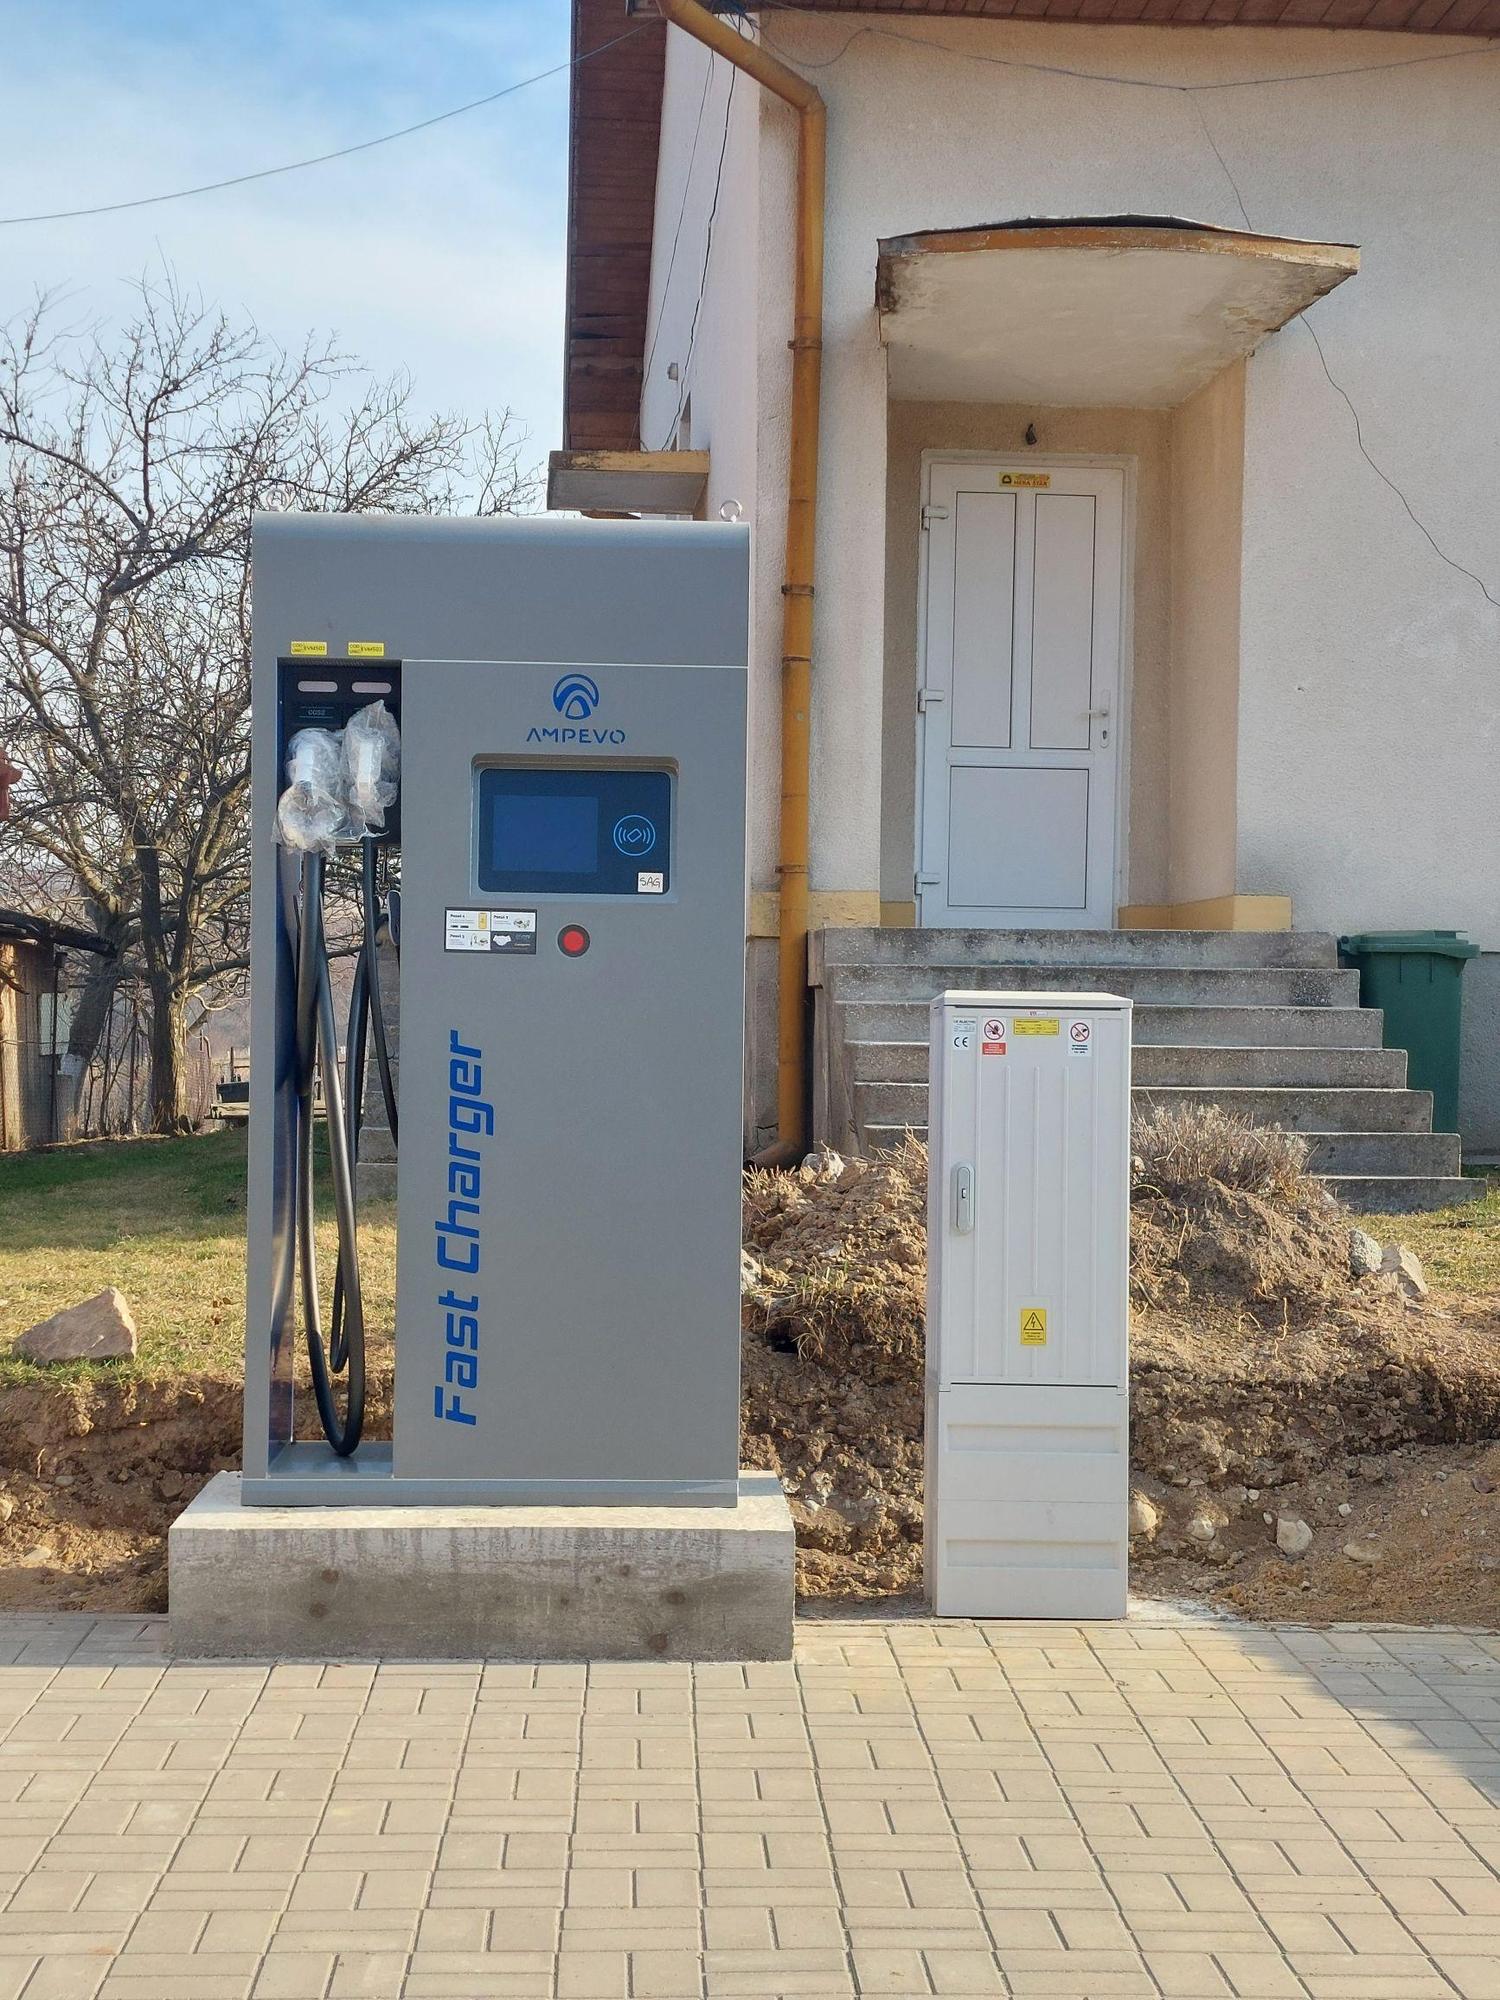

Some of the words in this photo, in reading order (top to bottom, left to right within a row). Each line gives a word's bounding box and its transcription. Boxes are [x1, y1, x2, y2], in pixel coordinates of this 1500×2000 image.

[526, 727, 626, 744] AMPEVO
[639, 876, 661, 889] SAG
[434, 1029, 494, 1275] Charger
[434, 1290, 479, 1426] Fast
